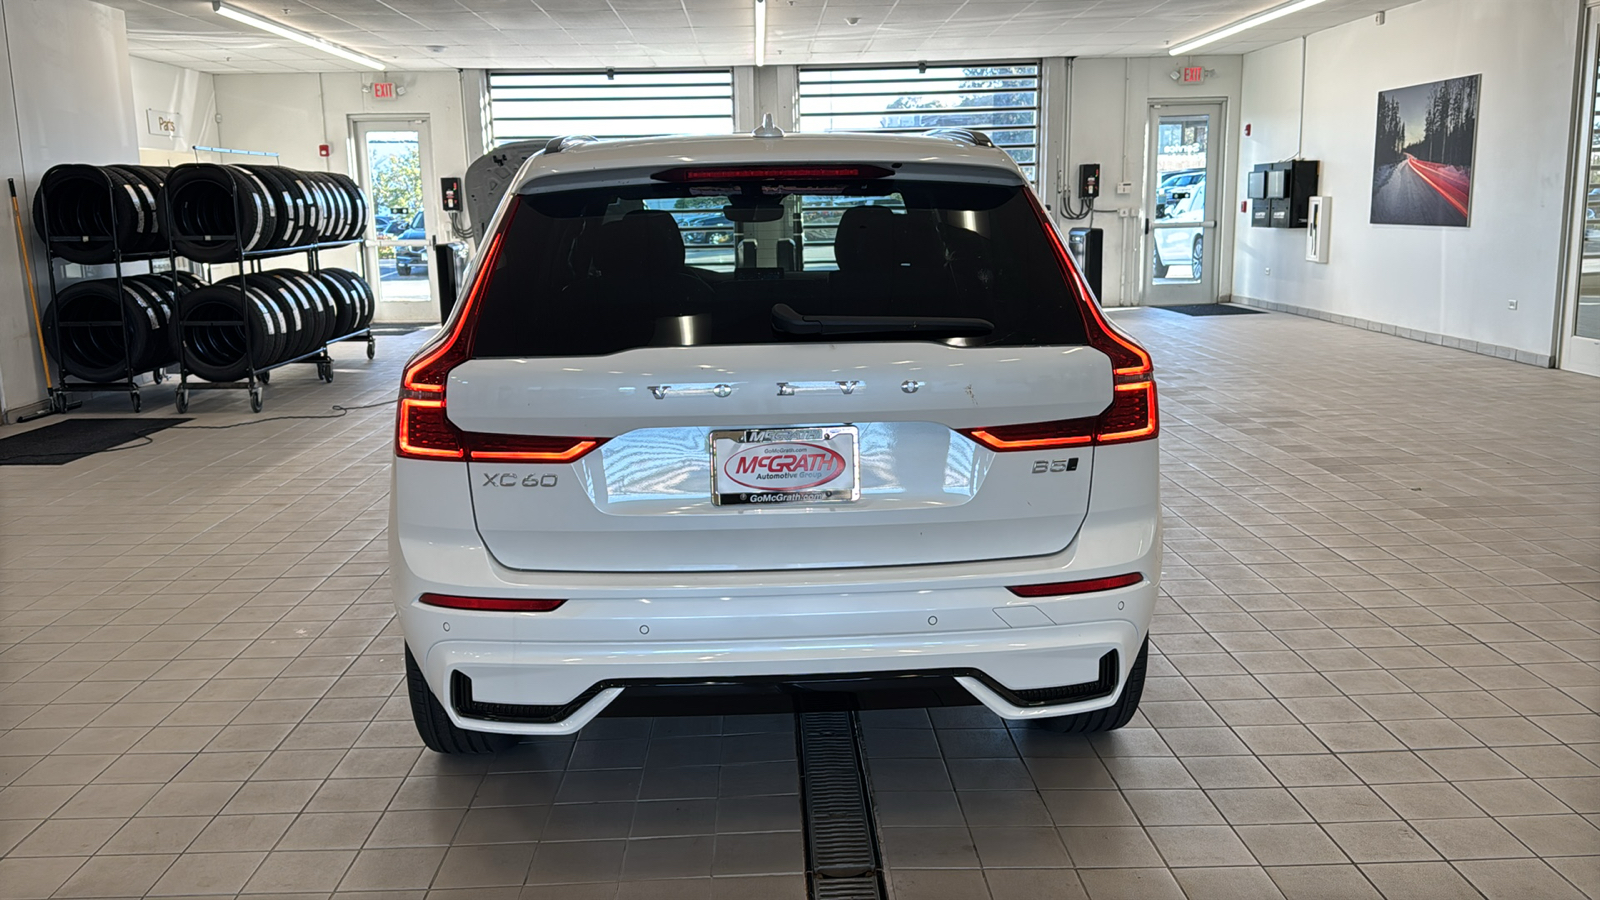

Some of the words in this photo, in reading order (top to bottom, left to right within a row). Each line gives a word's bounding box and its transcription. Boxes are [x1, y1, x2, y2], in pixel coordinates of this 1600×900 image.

[1184, 67, 1202, 81] EXIT
[374, 83, 393, 97] EXIT
[647, 379, 919, 400] VOLVO
[764, 446, 808, 455] GoMcGrath.com
[1032, 459, 1067, 474] B5
[482, 472, 558, 488] XC60
[756, 471, 798, 481] Automotive
[799, 471, 823, 480] Group
[749, 491, 824, 503] GoMcGrath.com
